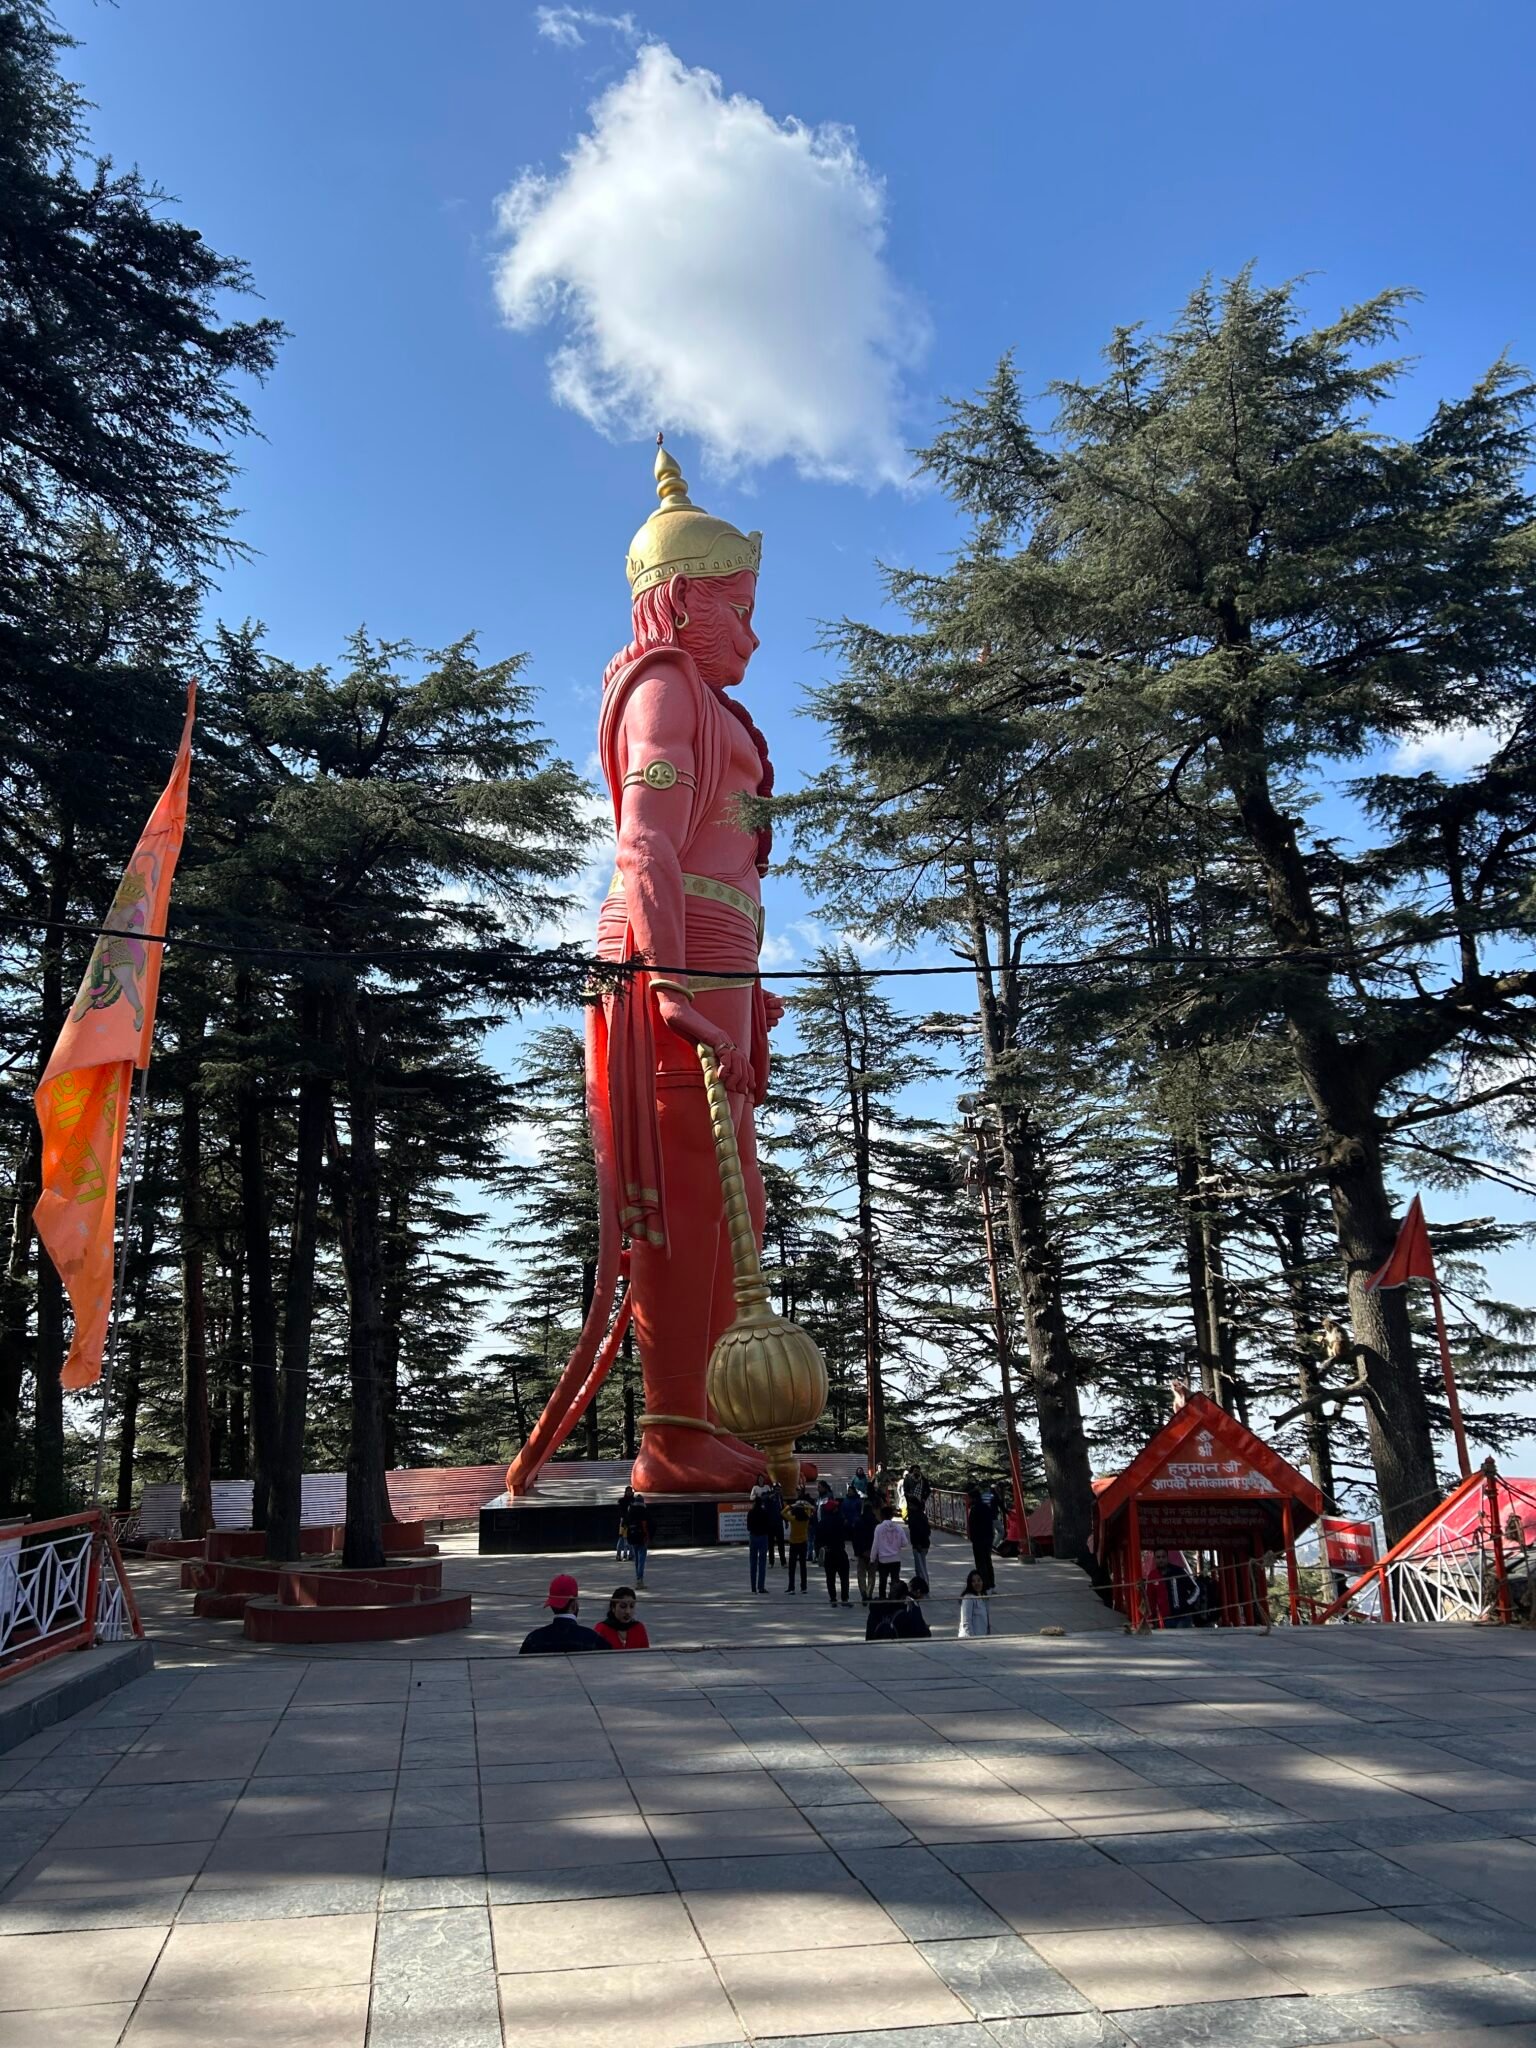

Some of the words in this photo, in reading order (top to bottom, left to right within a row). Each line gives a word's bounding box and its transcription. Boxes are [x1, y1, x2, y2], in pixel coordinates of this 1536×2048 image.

[1168, 1463, 1219, 1477] हनुमान
[1222, 1460, 1242, 1473] जी
[1152, 1475, 1187, 1490] आपकी
[1189, 1476, 1240, 1489] मनोकामना
